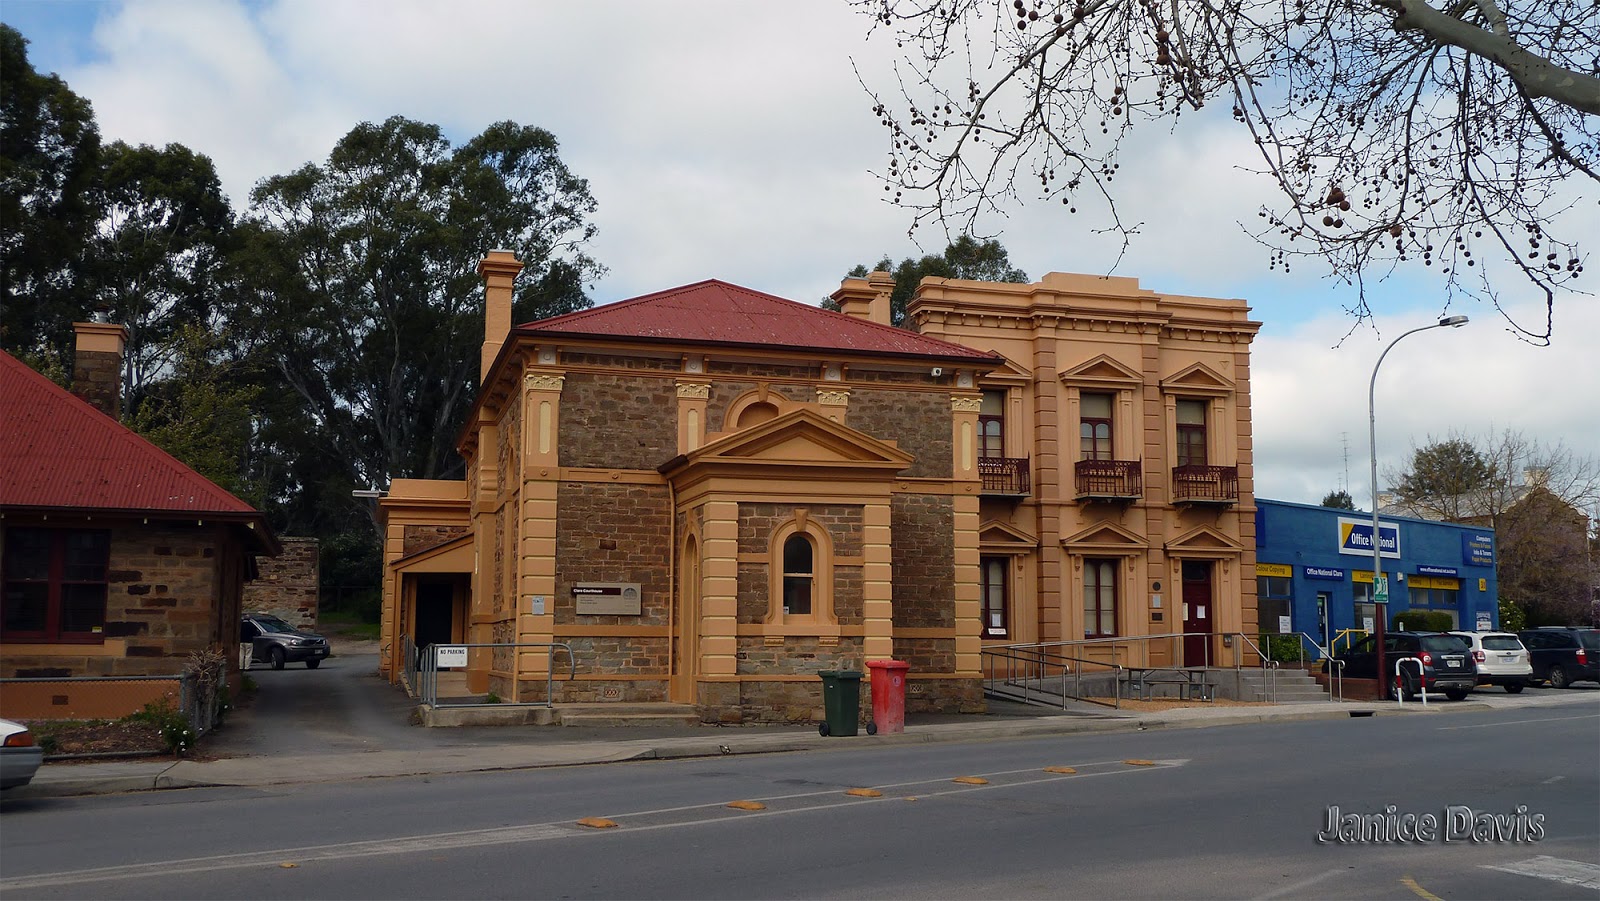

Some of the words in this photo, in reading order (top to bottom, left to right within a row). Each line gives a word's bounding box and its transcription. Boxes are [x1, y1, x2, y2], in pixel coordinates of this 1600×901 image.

[1351, 533, 1369, 546] Office
[1256, 564, 1269, 572] Colour
[1270, 565, 1286, 575] Copying
